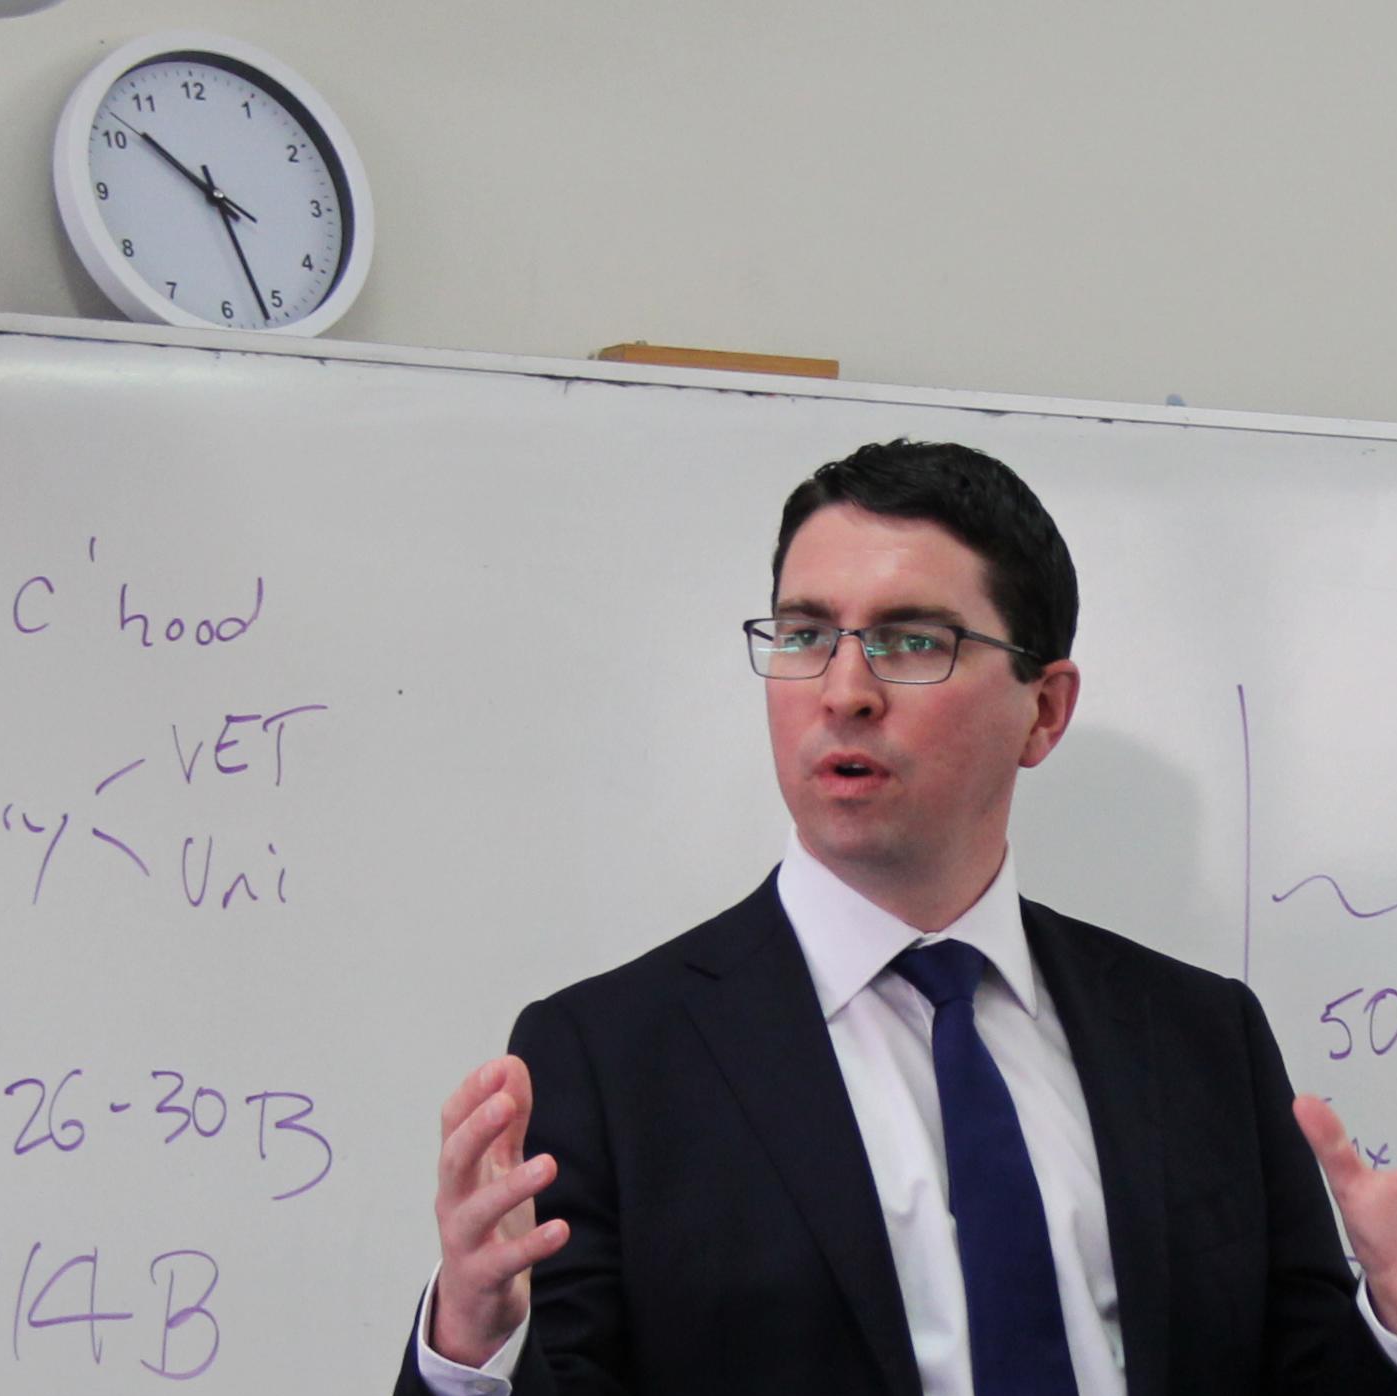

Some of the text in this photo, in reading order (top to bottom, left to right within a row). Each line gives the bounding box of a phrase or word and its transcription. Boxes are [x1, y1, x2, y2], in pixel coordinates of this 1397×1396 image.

[180, 81, 206, 101] 12
[131, 93, 156, 112] 11
[240, 101, 252, 119] 1
[101, 130, 127, 150] 10
[286, 144, 300, 164] 2
[95, 182, 109, 201] 9
[309, 200, 323, 219] 3
[121, 238, 135, 258] 8
[301, 253, 314, 272] 4
[165, 281, 178, 300] 7
[270, 289, 284, 308] 5
[221, 300, 235, 319] 6
[171, 703, 328, 787] VET
[181, 837, 288, 907] Uni
